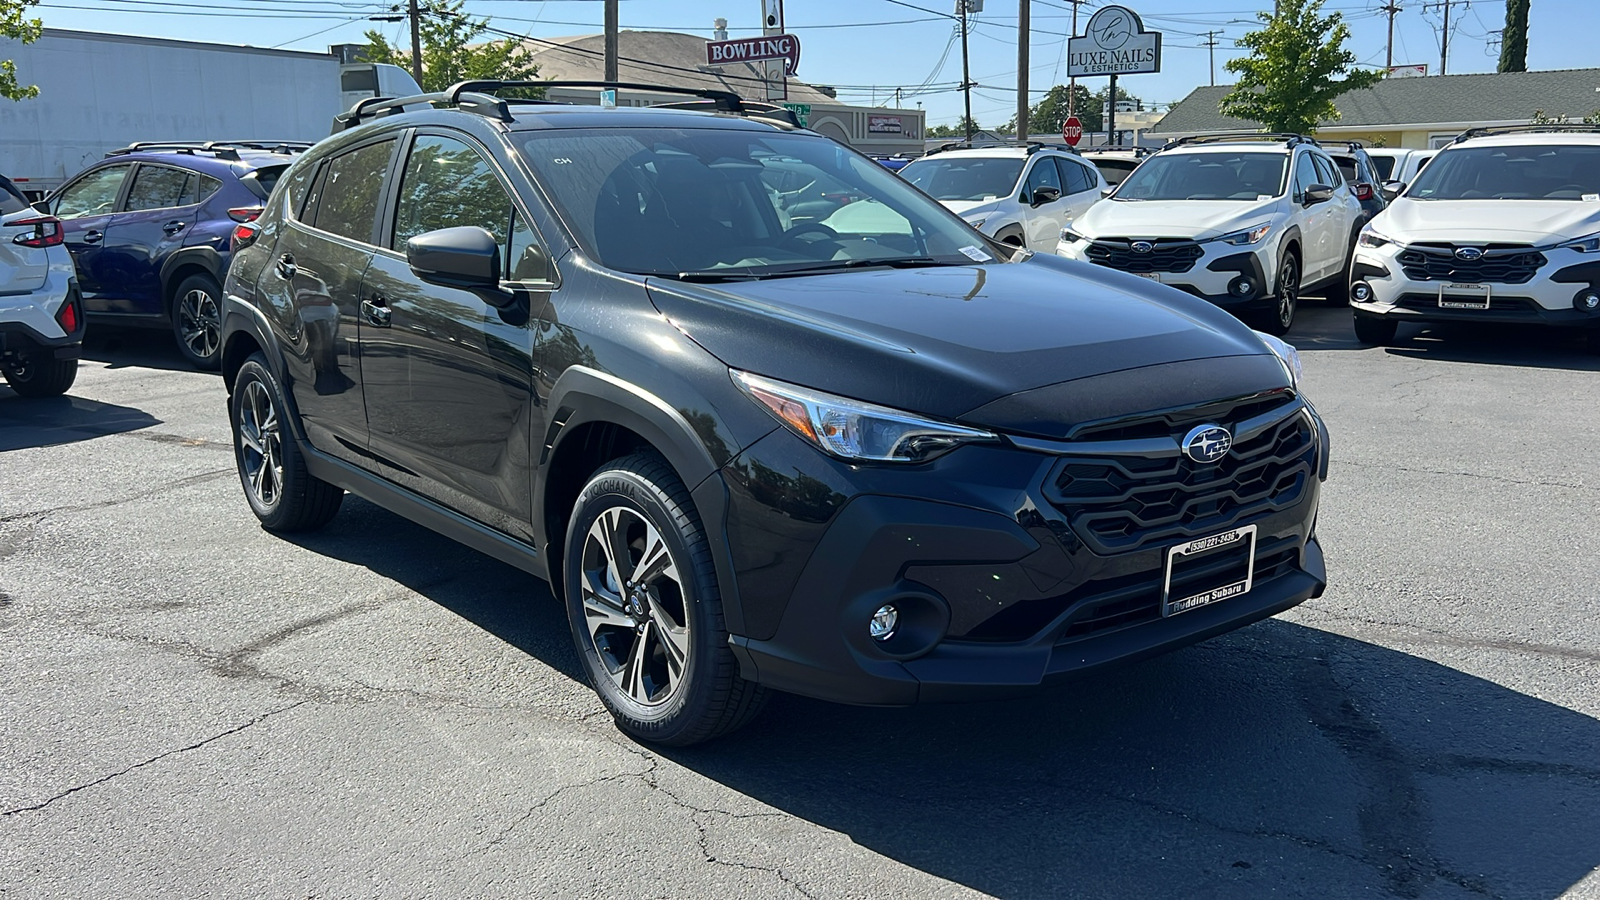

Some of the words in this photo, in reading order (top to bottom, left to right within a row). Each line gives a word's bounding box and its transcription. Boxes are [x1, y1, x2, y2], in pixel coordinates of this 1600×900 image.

[712, 39, 791, 60] BOWLING
[1070, 51, 1107, 66] LUXE
[1110, 48, 1154, 64] NAILS
[1083, 65, 1089, 73] &
[1092, 62, 1139, 72] ESTHETICS
[1065, 126, 1081, 137] STOP
[589, 479, 636, 499] YOKOHAMA
[1173, 595, 1210, 612] Redding
[1211, 584, 1242, 600] Subaru
